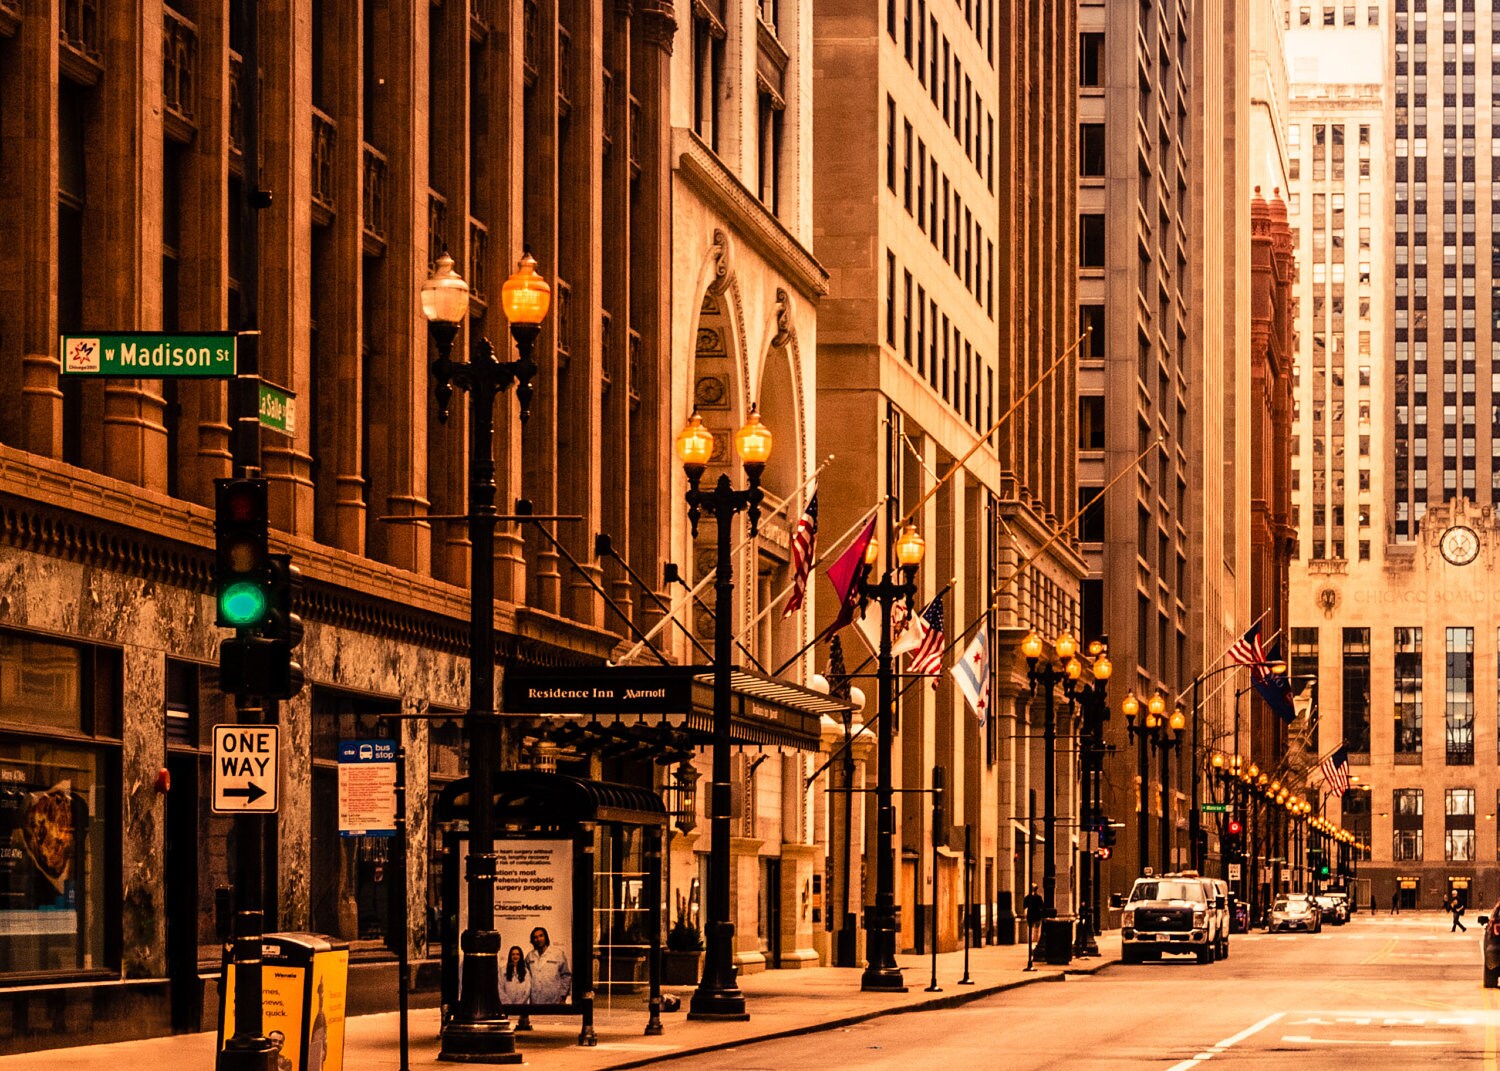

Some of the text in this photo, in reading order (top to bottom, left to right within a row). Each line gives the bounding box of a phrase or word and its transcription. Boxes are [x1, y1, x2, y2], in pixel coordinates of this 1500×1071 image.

[104, 343, 229, 366] W Madison St
[1354, 590, 1427, 604] CHICAGO
[1434, 590, 1485, 604] BOARD
[529, 688, 665, 699] Residence Inn Marriott
[223, 733, 270, 753] ONE
[375, 751, 393, 760] stop
[221, 757, 270, 777] WAY
